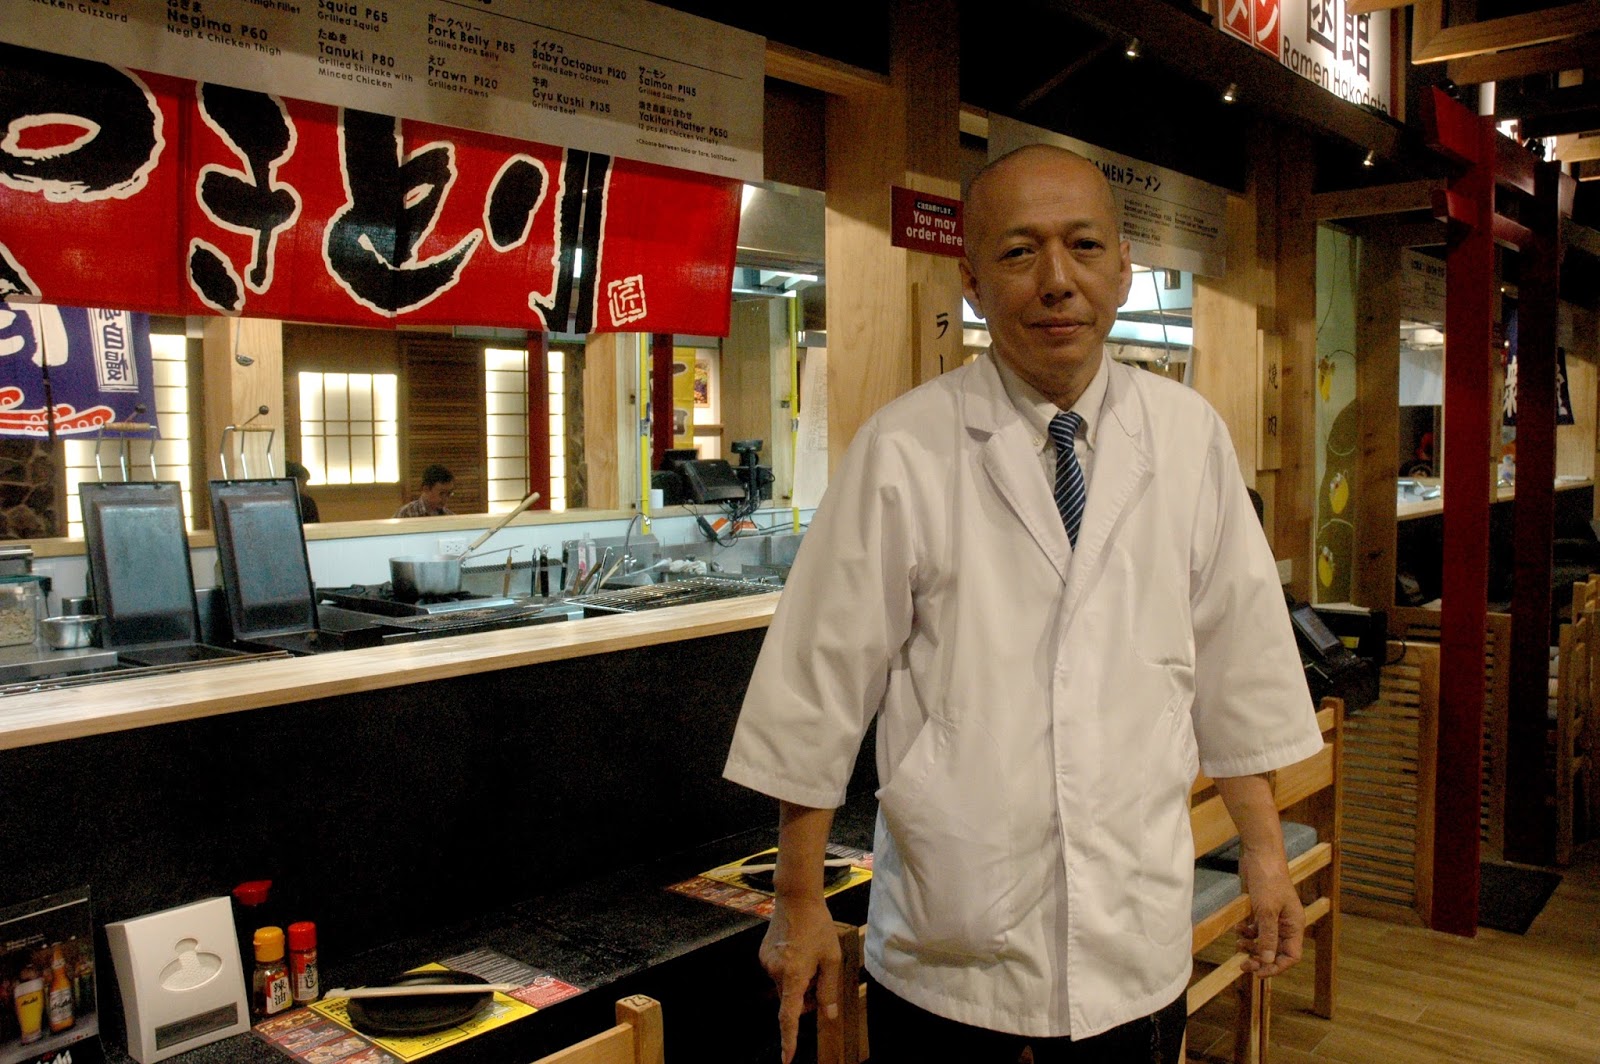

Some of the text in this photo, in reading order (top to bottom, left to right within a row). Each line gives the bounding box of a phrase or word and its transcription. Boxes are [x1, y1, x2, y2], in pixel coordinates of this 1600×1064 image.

[78, 4, 128, 23] Gizzard
[277, 2, 300, 14] Fillet
[318, 0, 388, 23] Squid P65
[167, 8, 268, 41] Negima P60
[317, 11, 379, 32] Grilled Squid
[167, 24, 281, 56] Negi & Chicken Thigh
[318, 28, 347, 44] たぬき
[428, 24, 516, 54] Pork Belly P85
[318, 41, 395, 68] Tanuki P80
[428, 37, 499, 62] Grilled Pork Belly
[428, 54, 446, 66] えび
[318, 56, 413, 82] Grilled Shiitake with
[532, 48, 627, 80] Baby Octopus P120
[532, 61, 609, 85] Grilled Baby Octopus
[638, 66, 666, 79] サーモン
[1283, 35, 1388, 113] Ramen Hakodate
[318, 68, 393, 89] Minced Chicken
[428, 66, 498, 90] Prawn P120
[428, 79, 489, 98] Grilled Prawns
[639, 75, 697, 97] Salmon P145
[532, 88, 610, 113] Gyu Kushi P135
[638, 86, 685, 102] Grilled Salmon
[532, 100, 576, 116] Grilled Beef
[639, 111, 728, 138] Yakitori Platter P650
[670, 130, 694, 140] Chicken
[696, 135, 719, 146] Variety
[913, 210, 957, 234] You may
[906, 226, 963, 247] order here
